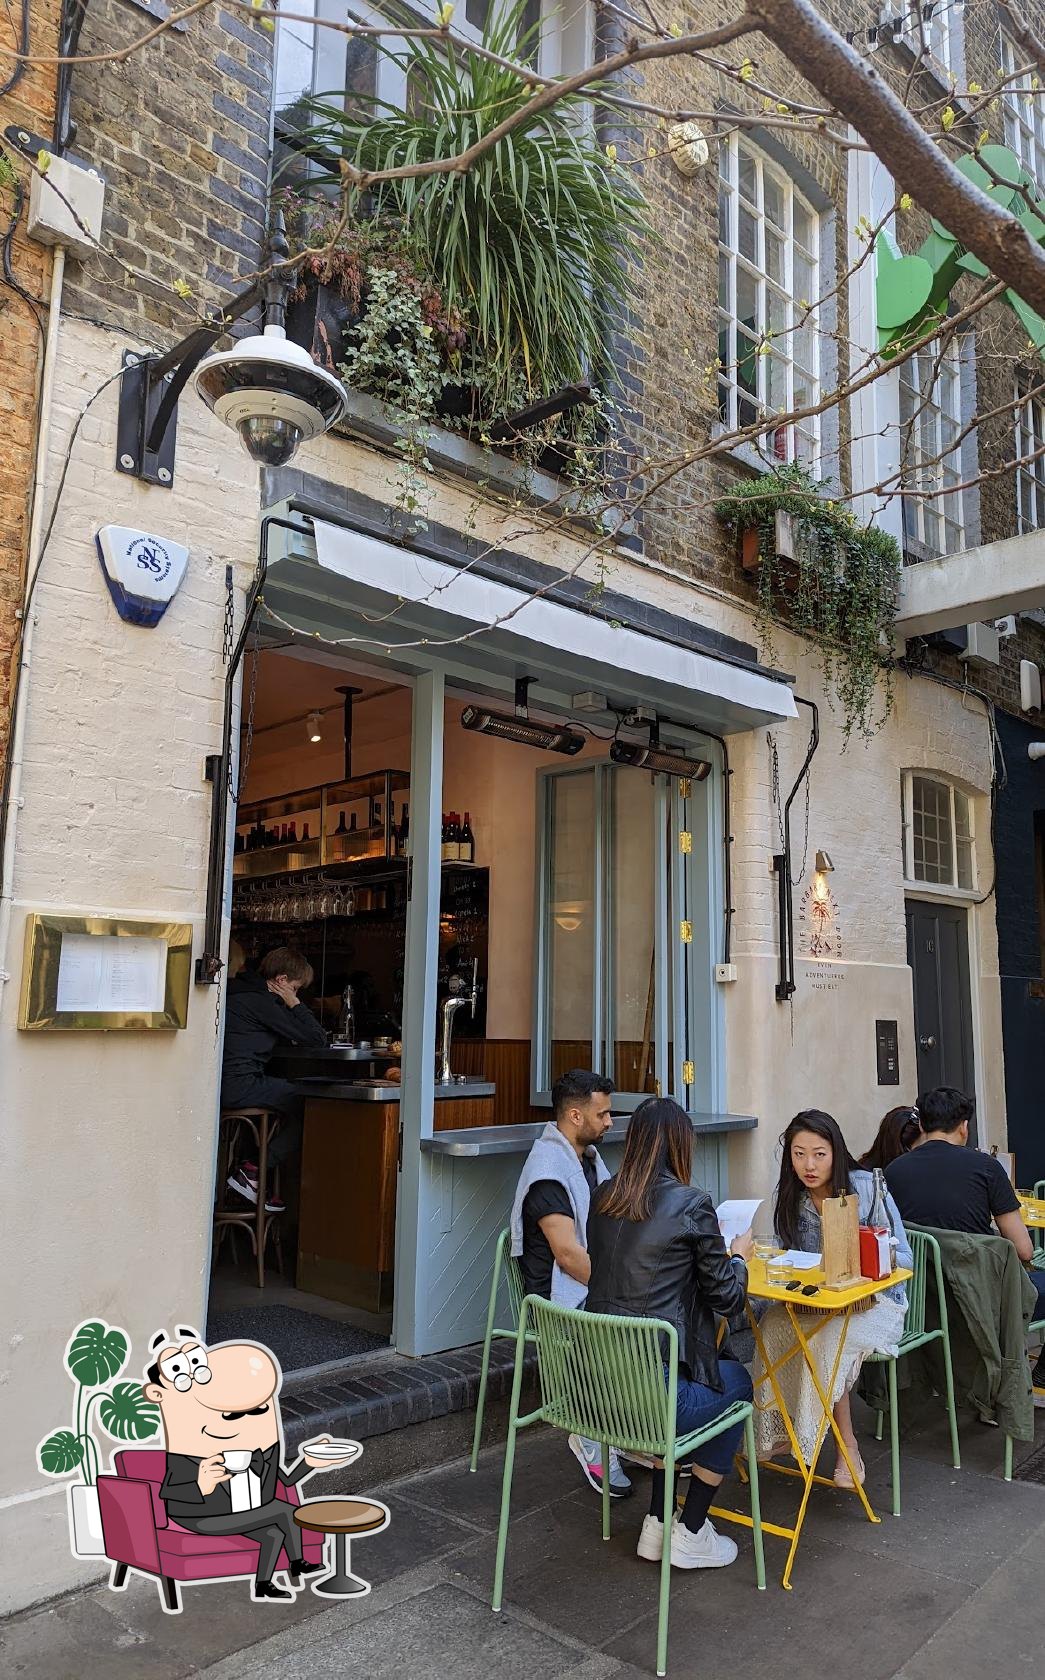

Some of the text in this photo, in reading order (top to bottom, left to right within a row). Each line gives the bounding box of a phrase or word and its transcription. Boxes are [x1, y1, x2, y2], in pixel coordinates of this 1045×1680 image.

[126, 537, 146, 556] National
[147, 537, 170, 561] Security
[835, 926, 843, 958] DOOR
